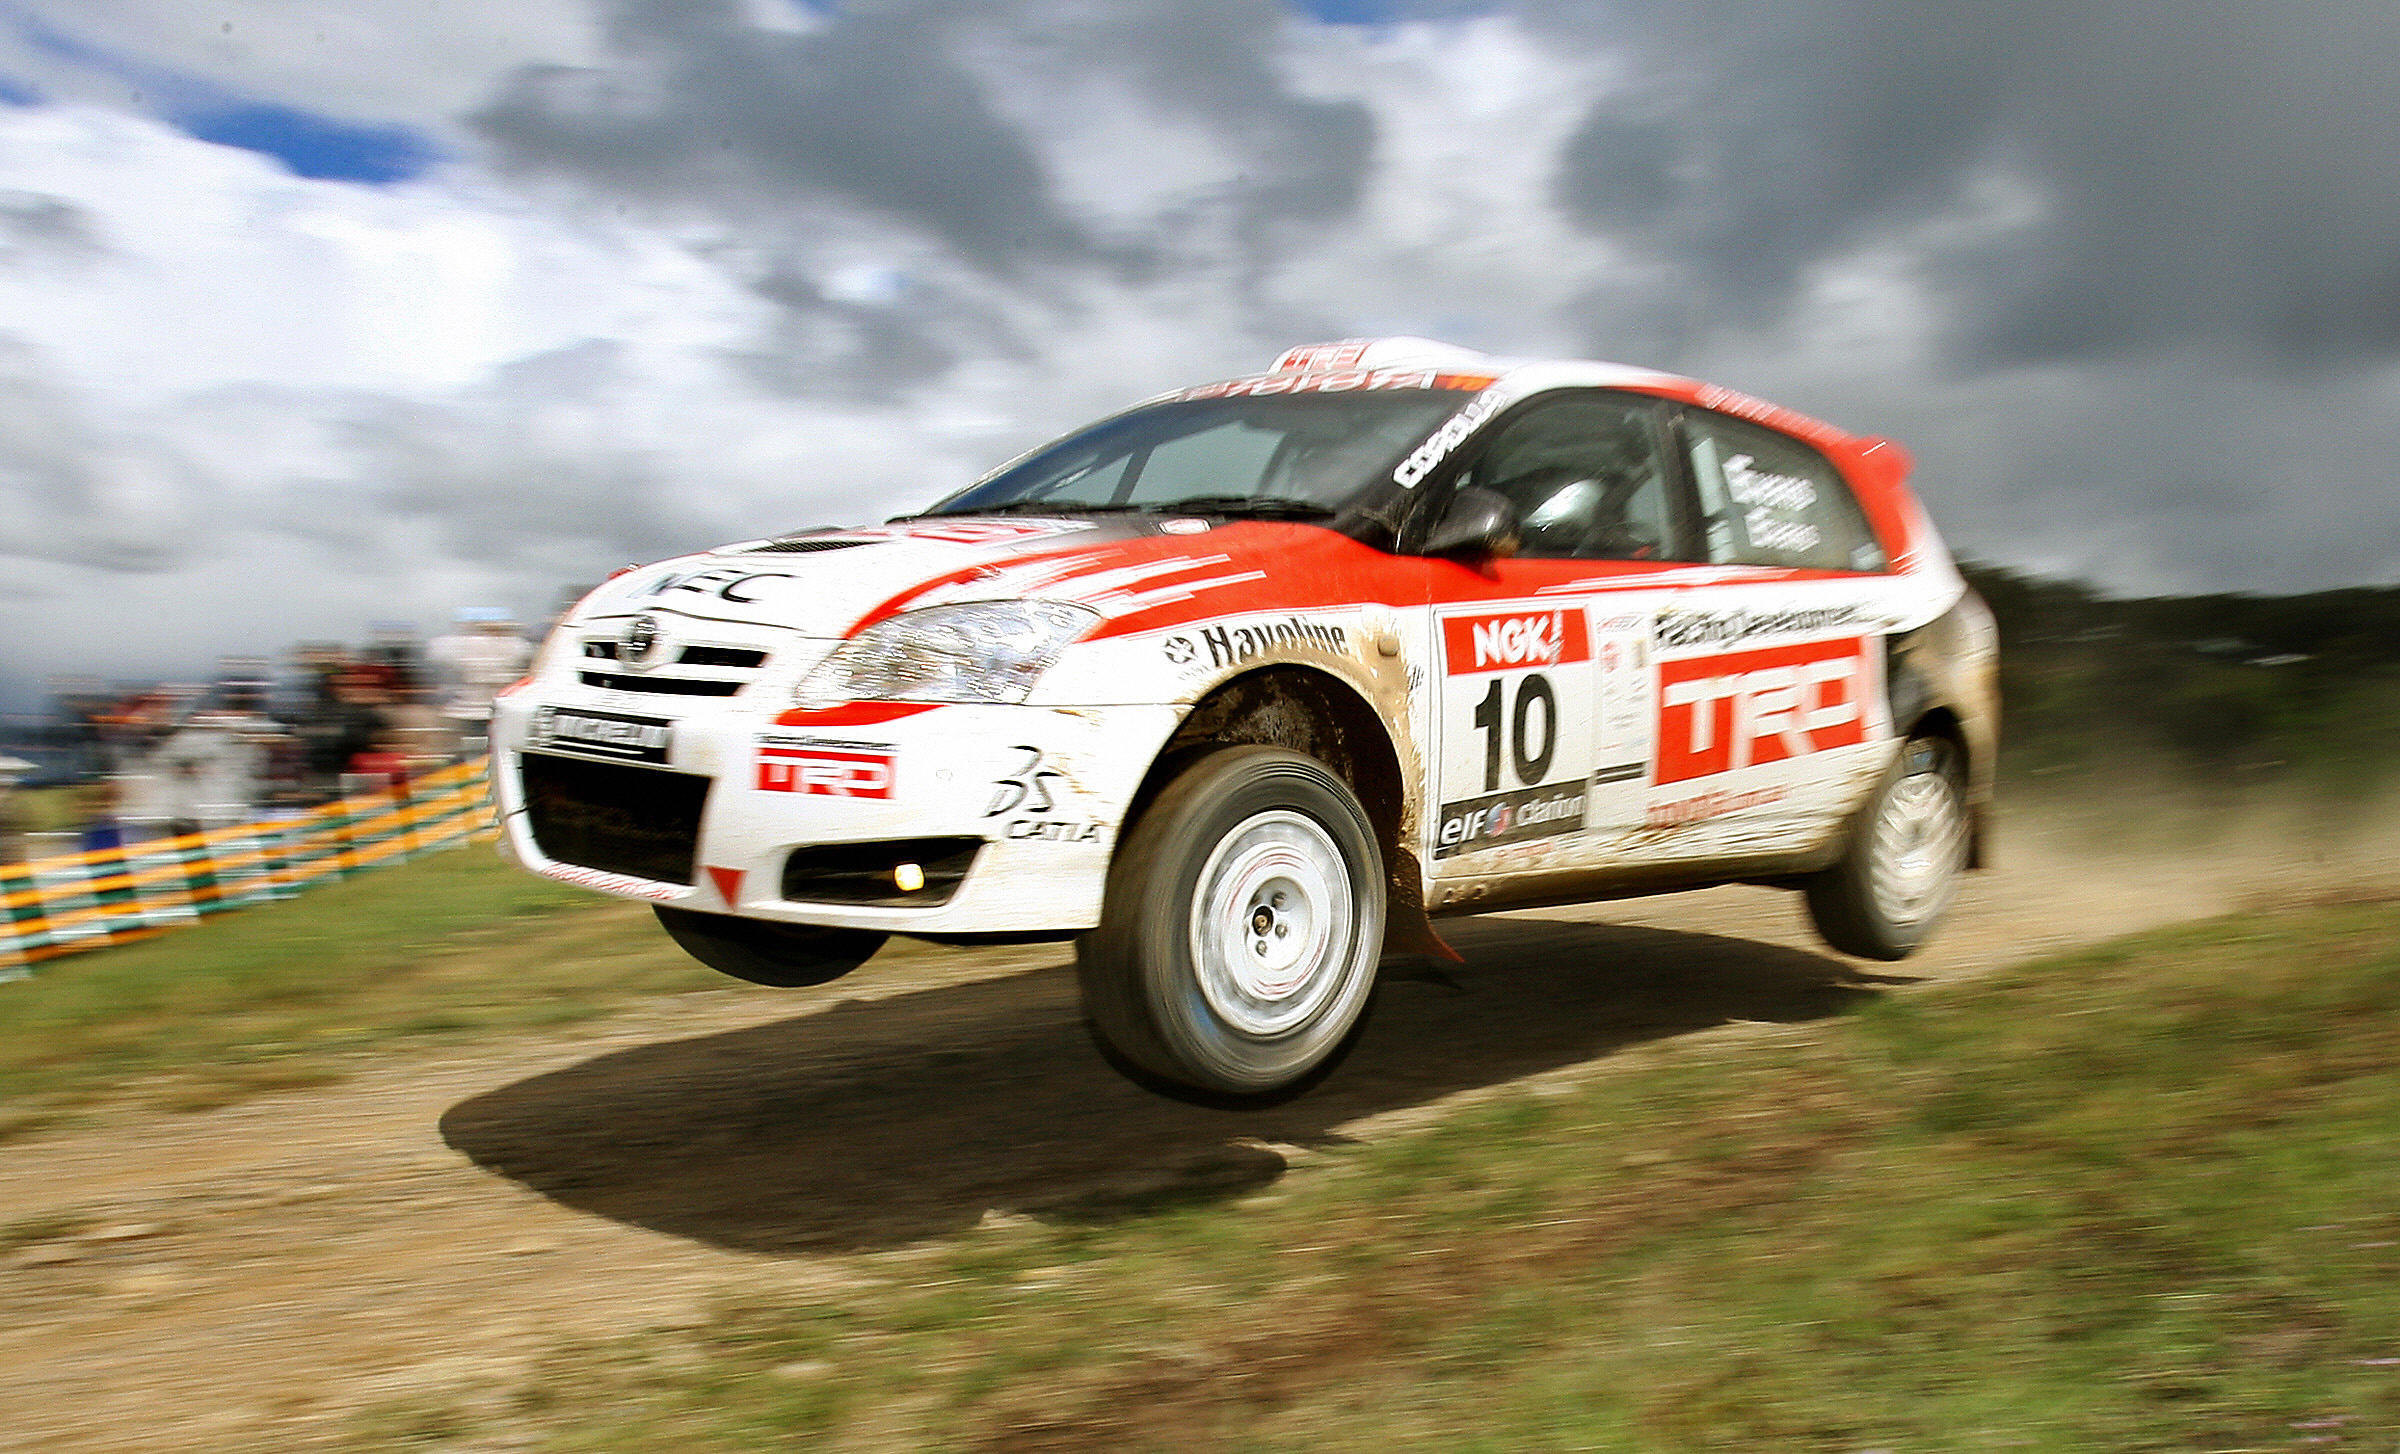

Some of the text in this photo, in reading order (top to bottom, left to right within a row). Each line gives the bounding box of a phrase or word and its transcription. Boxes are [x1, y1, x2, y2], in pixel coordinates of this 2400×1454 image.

[1201, 615, 1349, 668] Havoline
[1474, 673, 1557, 792] 10
[1660, 656, 1866, 770] TRD
[1004, 819, 1101, 843] CATIA
